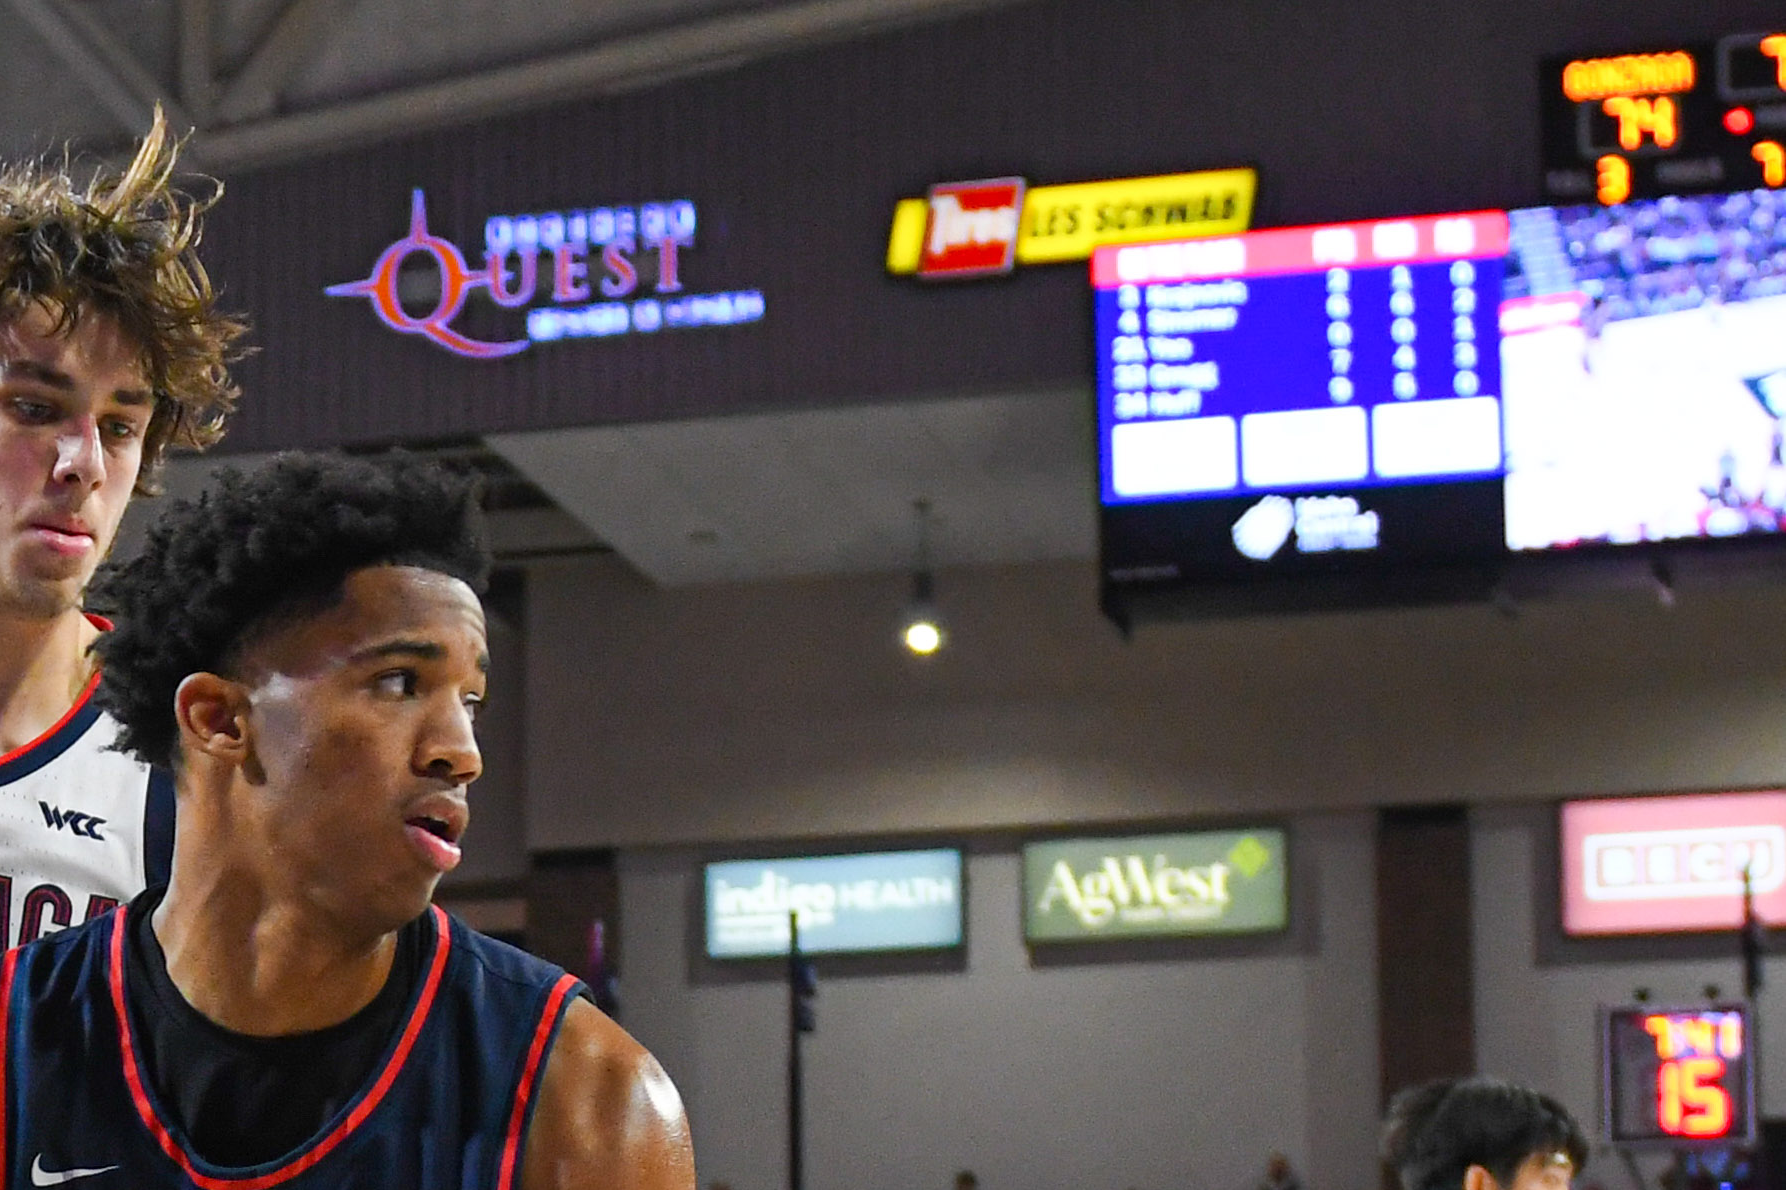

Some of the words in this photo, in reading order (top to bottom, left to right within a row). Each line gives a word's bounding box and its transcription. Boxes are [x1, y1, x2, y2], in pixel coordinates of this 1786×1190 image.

[38, 800, 108, 841] WCC
[1037, 853, 1231, 928] AgWest
[1657, 1056, 1733, 1138] 15
